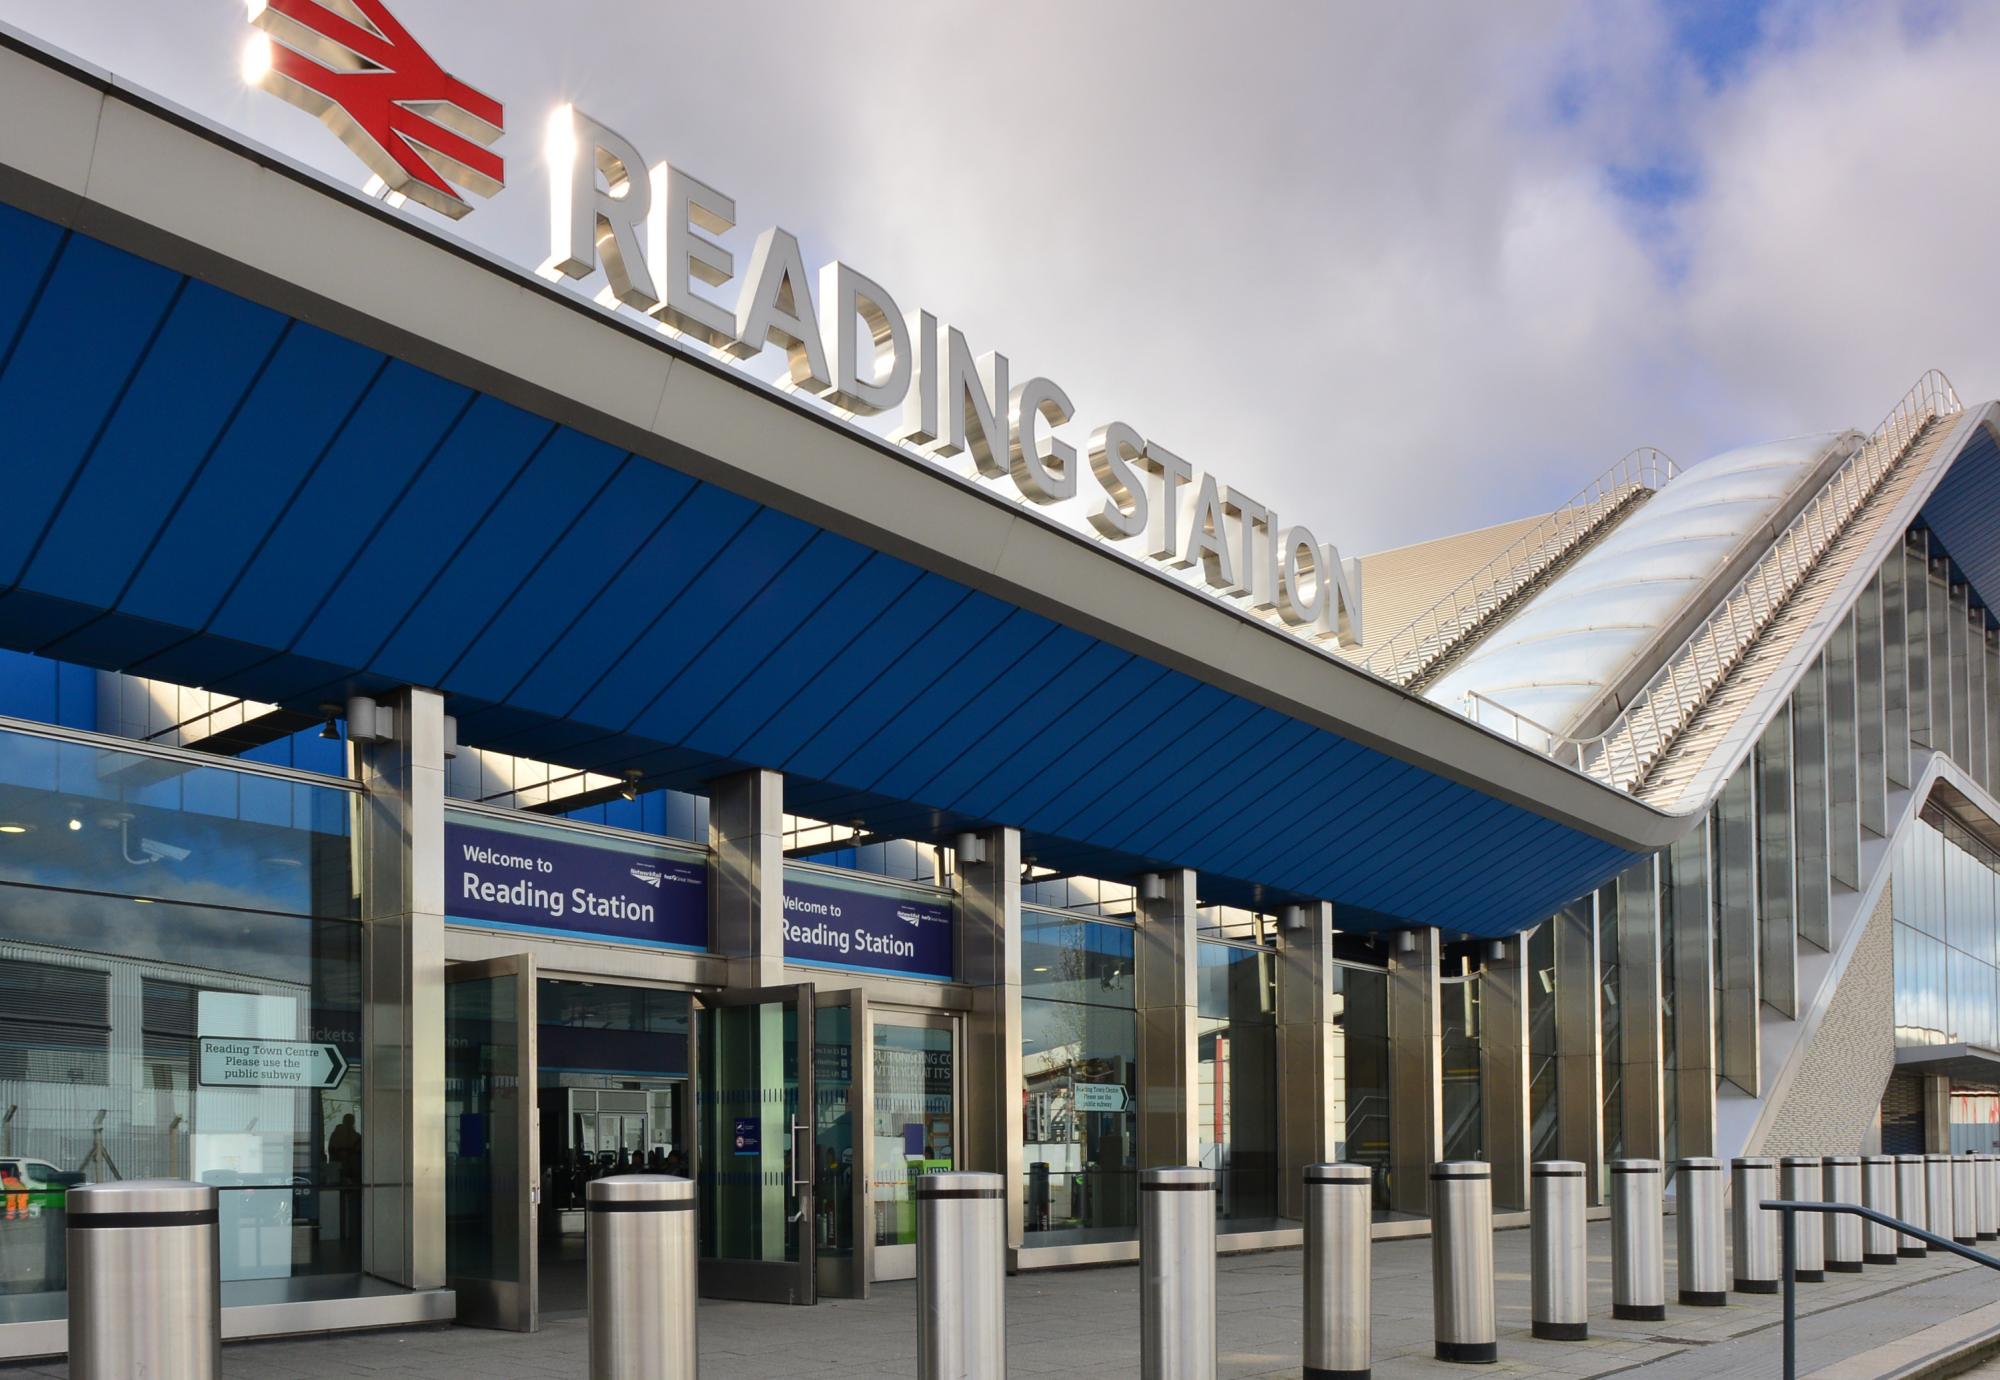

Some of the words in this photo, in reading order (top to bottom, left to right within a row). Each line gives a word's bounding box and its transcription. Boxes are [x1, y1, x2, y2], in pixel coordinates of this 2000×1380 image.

[546, 102, 1077, 505] READING
[1086, 420, 1362, 647] STATION
[463, 844, 533, 870] Welcome
[537, 857, 553, 873] to
[463, 872, 564, 917] Reading
[571, 888, 654, 923] Station
[783, 895, 828, 915] Welcome
[830, 904, 841, 917] to
[783, 918, 849, 954] Reading
[855, 929, 914, 957] Station
[302, 1024, 355, 1042] Tickets
[205, 1043, 250, 1056] Reading
[252, 1045, 283, 1056] Town
[285, 1047, 319, 1057] Centre
[225, 1056, 260, 1067] Please
[262, 1059, 280, 1068] use
[283, 1058, 300, 1068] the
[224, 1069, 258, 1079] public
[261, 1070, 302, 1081] subway
[934, 1067, 951, 1079] ITS
